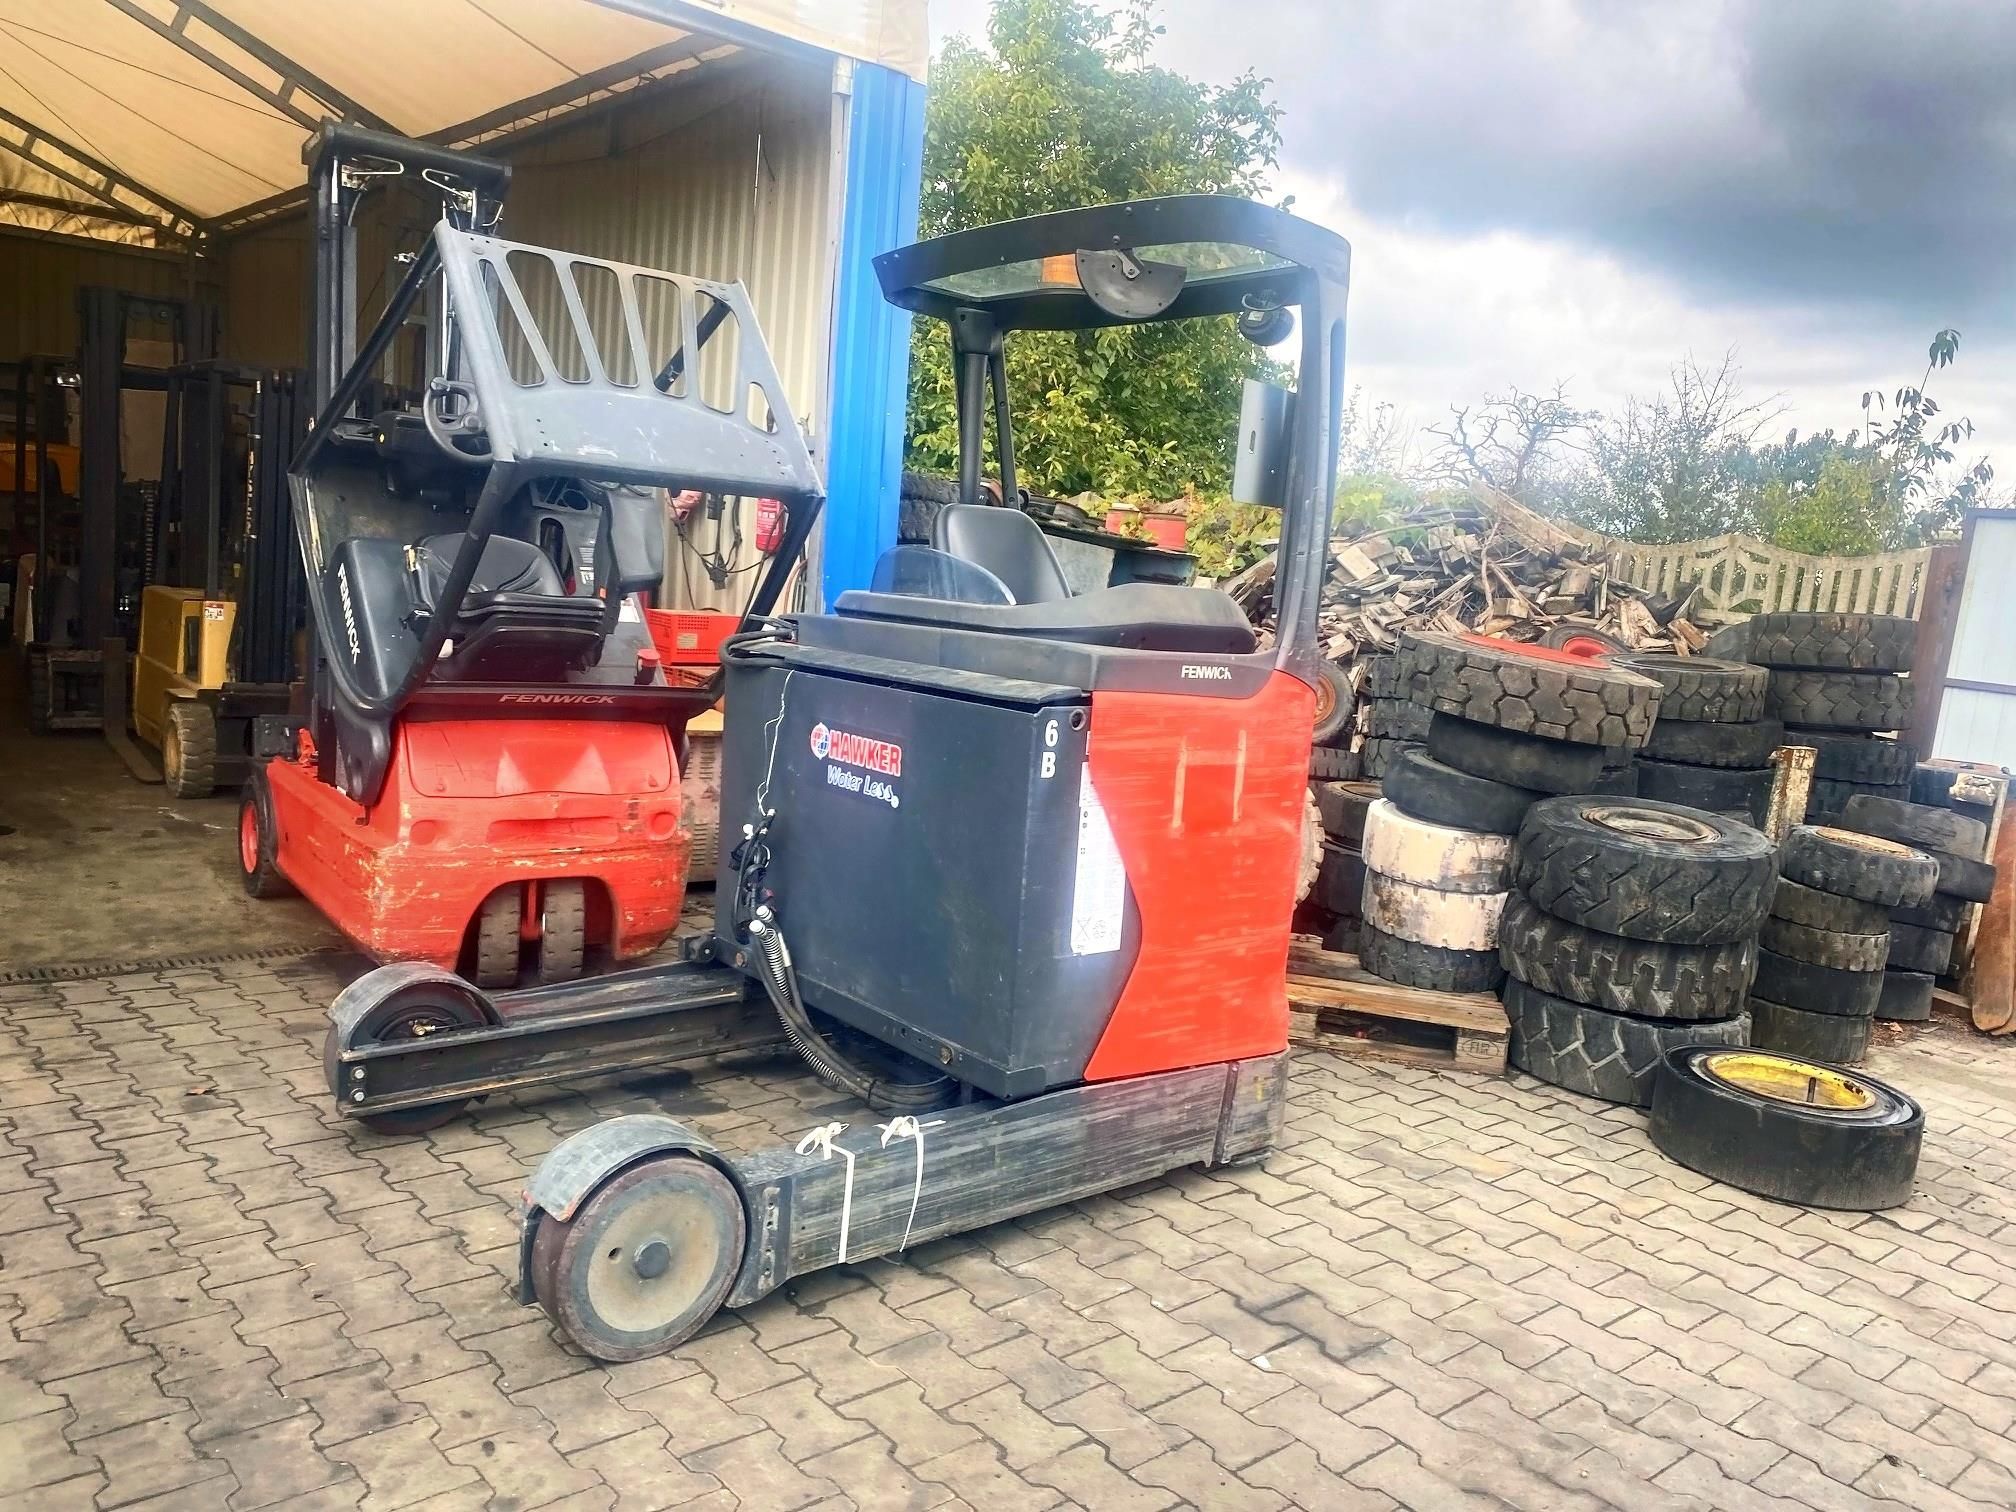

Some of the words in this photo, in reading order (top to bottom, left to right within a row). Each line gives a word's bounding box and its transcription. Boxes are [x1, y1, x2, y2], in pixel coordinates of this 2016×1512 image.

[338, 562, 361, 665] FENWICK
[1181, 664, 1232, 680] FENWICK
[499, 694, 617, 704] FENWICK
[1045, 719, 1059, 748] 6
[828, 729, 902, 777] HAWKER
[1040, 751, 1056, 778] B
[827, 764, 863, 792] Water
